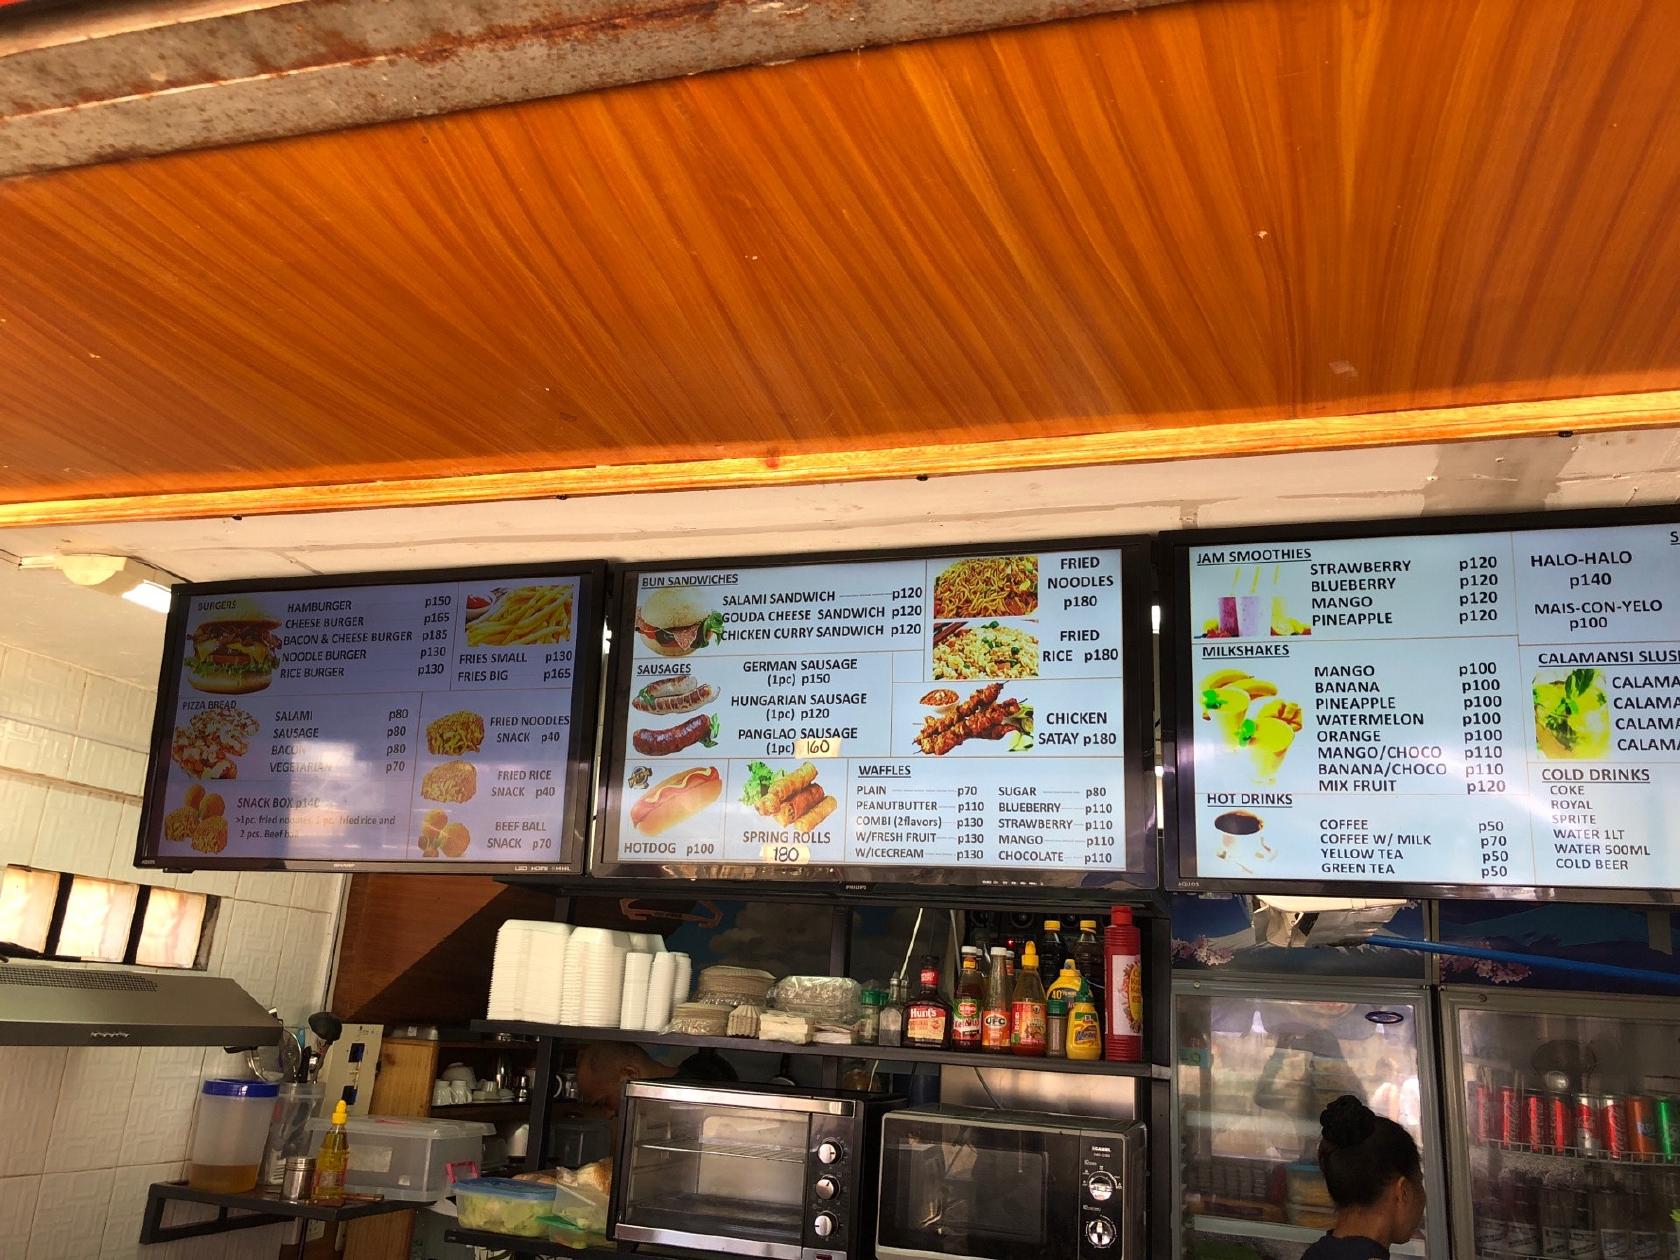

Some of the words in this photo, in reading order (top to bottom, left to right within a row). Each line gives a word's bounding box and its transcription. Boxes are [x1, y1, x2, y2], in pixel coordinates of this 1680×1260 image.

[1060, 557, 1100, 570] FRIED
[1197, 552, 1225, 564] JAM
[1229, 549, 1312, 562] SMOOTHIES
[1531, 551, 1632, 567] HALO-HALO
[1310, 560, 1412, 575] STRAWBERRY
[1459, 556, 1498, 572] p120
[642, 576, 665, 588] BUN
[668, 574, 738, 586] SANDWICHES
[1047, 576, 1114, 589] NOODLES
[1311, 577, 1396, 592] BLUEBERRY
[1459, 574, 1498, 590] p120
[1570, 573, 1612, 589] p140
[722, 594, 767, 606] SALAMI
[770, 591, 835, 604] SANDWICH
[892, 588, 923, 601] p120
[1063, 596, 1097, 610] p180
[1312, 596, 1373, 608] MANGO
[1459, 591, 1498, 607] p120
[287, 600, 352, 613] HAMBURGER
[425, 596, 451, 607] p150
[1535, 600, 1662, 615] MAIS-CON-YELO
[285, 618, 321, 629] CHEESE
[324, 617, 364, 627] BURGER
[424, 613, 450, 625] p165
[722, 611, 764, 623] GOUDA
[768, 609, 811, 621] CHEESE
[818, 607, 885, 620] SANDWICH
[892, 605, 922, 619] p120
[1312, 612, 1393, 626] PINEAPPLE
[1459, 609, 1498, 624] p120
[1570, 617, 1608, 631] p100
[284, 634, 319, 646] BACON
[321, 634, 329, 644] &
[332, 632, 368, 644] CHEESE
[371, 632, 413, 642] BURGER
[422, 630, 448, 641] p185
[721, 628, 770, 640] CHICKEN
[774, 627, 813, 639] CURRY
[816, 625, 884, 637] SANDWICH
[891, 624, 921, 637] p120
[1060, 630, 1100, 642] FRIED
[459, 654, 488, 664] FRIES
[491, 653, 528, 663] SMALL
[545, 651, 573, 663] p130
[1043, 650, 1073, 662] RICE
[1084, 649, 1119, 663] p180
[1202, 645, 1290, 657] MILKSHAKES
[1538, 651, 1633, 664] CALAMANSI
[1639, 650, 1680, 662] SLUS
[637, 663, 691, 675] SAUSAGES
[743, 661, 797, 672] GERMAN
[800, 659, 858, 671] SAUSAGE
[1314, 665, 1375, 677] MANGO
[1459, 663, 1497, 676] p100
[458, 671, 486, 682] FRIES
[490, 670, 509, 680] BIG
[544, 668, 571, 681] p165
[767, 674, 796, 687] (1pc)
[801, 674, 830, 686] p150
[1315, 682, 1380, 694] BANANA
[1462, 679, 1501, 694] p100
[182, 701, 206, 710] PIZZA
[207, 700, 237, 710] BREAD
[731, 694, 807, 706] HUNGARIAN
[810, 693, 867, 704] SAUSAGE
[1316, 697, 1396, 710] PINEAPPLE
[1463, 696, 1502, 710] p100
[275, 710, 313, 722] SALAMI
[388, 709, 409, 721] p80
[490, 716, 518, 726] FRIED
[521, 715, 570, 726] NOODLES
[766, 709, 795, 722] (1pc)
[801, 708, 829, 721] p120
[1046, 712, 1108, 725] CHICKEN
[1316, 713, 1424, 726] WATERMELON
[1462, 713, 1502, 727] p100
[273, 728, 319, 739] SAUSAGE
[387, 726, 406, 738] p80
[497, 732, 530, 743] SNACK
[541, 732, 560, 743] p40
[738, 728, 796, 740] PANGLAO
[800, 727, 858, 739] SAUSAGE
[1316, 730, 1381, 743] ORANGE
[1464, 729, 1503, 744] p100
[807, 740, 830, 754] 160
[1038, 733, 1079, 745] SATAY
[1083, 733, 1117, 747] p180
[766, 743, 795, 756] (1pc)
[1318, 746, 1442, 760] MANGO/CHOCO
[1464, 746, 1503, 761] p110
[858, 765, 911, 776] WAFFLES
[1318, 763, 1447, 776] BANANA/CHOCO
[1465, 763, 1504, 778] p110
[1542, 769, 1584, 781] COLD
[1590, 768, 1650, 781] DRINKS
[857, 786, 887, 796] PLAIN
[957, 786, 977, 797] p70
[998, 786, 1037, 797] SUGAR
[1086, 787, 1107, 798] p80
[1319, 780, 1349, 792] MIX
[1353, 779, 1397, 792] FRUIT
[1466, 780, 1506, 795] p120
[1550, 785, 1585, 795] COKE
[1207, 793, 1237, 805] HOT
[1241, 793, 1293, 805] DRINKS
[1551, 800, 1593, 810] ROYAL
[856, 801, 937, 811] PEANUTBUTTER
[958, 801, 985, 813] p110
[998, 803, 1061, 813] BLUEBERRY
[1085, 803, 1112, 815] p110
[856, 816, 891, 826] COMBI
[894, 816, 942, 828] (2flavors)
[957, 817, 984, 830] p130
[998, 818, 1073, 829] STRAWBERRY
[1085, 819, 1113, 831] p110
[1319, 819, 1368, 831] COFFEE
[1478, 821, 1504, 833] p50
[743, 831, 788, 844] SPRING
[793, 831, 831, 844] ROLLS
[856, 832, 903, 843] W/FRESH
[906, 832, 937, 843] FRUIT
[957, 833, 984, 845] p130
[999, 835, 1043, 845] MANGO
[1086, 836, 1114, 848] p110
[1320, 834, 1369, 846] COFFEE
[1373, 833, 1393, 846] W/
[1397, 835, 1432, 846] MILK
[1480, 836, 1507, 849] p70
[1553, 829, 1600, 840] WATER
[1605, 829, 1625, 840] 1LT
[624, 842, 676, 854] HOTDOG
[686, 843, 714, 856] p100
[774, 847, 799, 862] 180
[855, 847, 924, 858] W/ICECREAM
[956, 849, 984, 861] p130
[1320, 848, 1375, 860] YELLOW
[1379, 849, 1403, 860] TEA
[1482, 850, 1509, 863] p50
[1554, 844, 1601, 855] WATER
[1605, 845, 1651, 856] 500ML
[998, 851, 1063, 861] CHOCOLATE
[1084, 852, 1112, 864] p110
[1556, 858, 1591, 869] COLD
[1595, 860, 1629, 870] BEER
[1321, 863, 1367, 874] GREEN
[1371, 863, 1395, 874] TEA
[1481, 866, 1508, 879] p50
[910, 1008, 937, 1018] Hunt's
